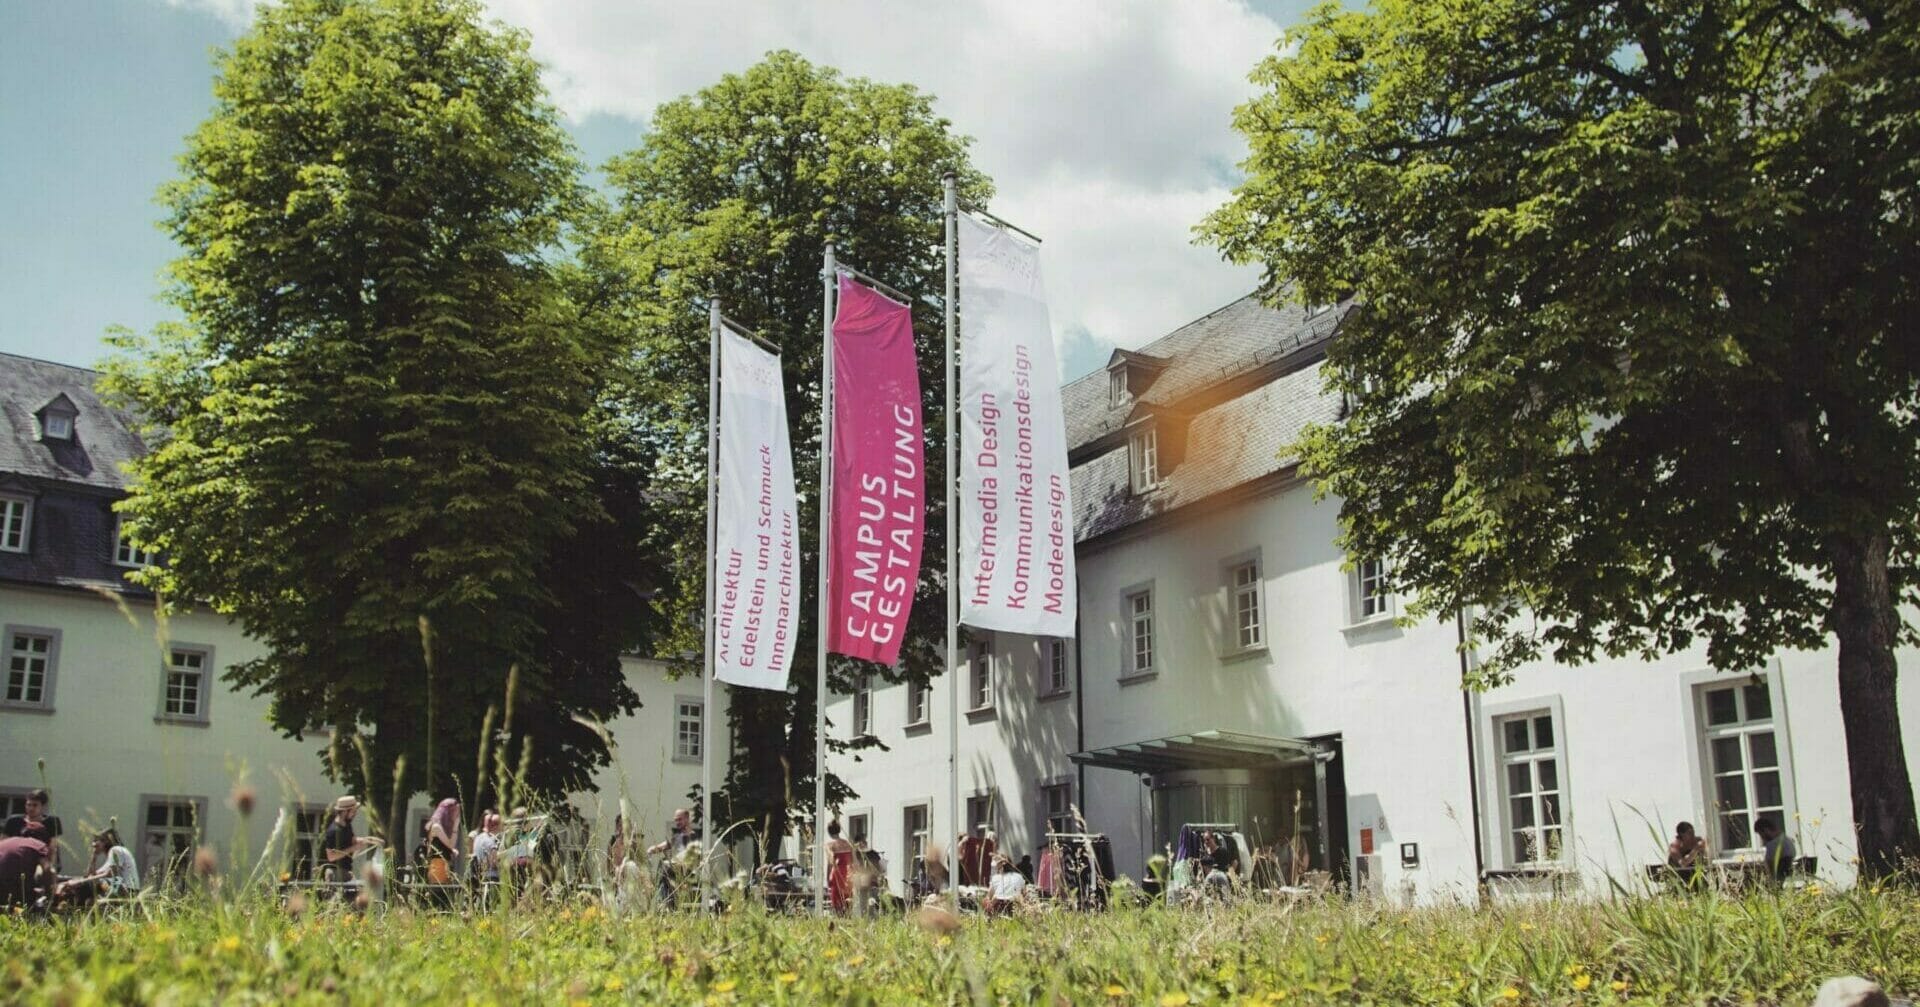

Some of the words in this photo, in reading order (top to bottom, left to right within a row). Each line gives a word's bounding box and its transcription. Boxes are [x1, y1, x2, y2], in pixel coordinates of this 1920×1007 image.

[758, 443, 772, 529] Schmuck
[977, 393, 1001, 468] Design
[1006, 344, 1033, 609] Kommunikationsdesign
[757, 534, 771, 571] und
[768, 510, 792, 671] Innenarchitektur
[847, 473, 887, 638] CAMPUS
[870, 404, 916, 644] GESTALTUNG
[971, 477, 997, 606] Intermedia
[1043, 474, 1065, 614] Modedesign
[740, 578, 766, 668] Edelstein
